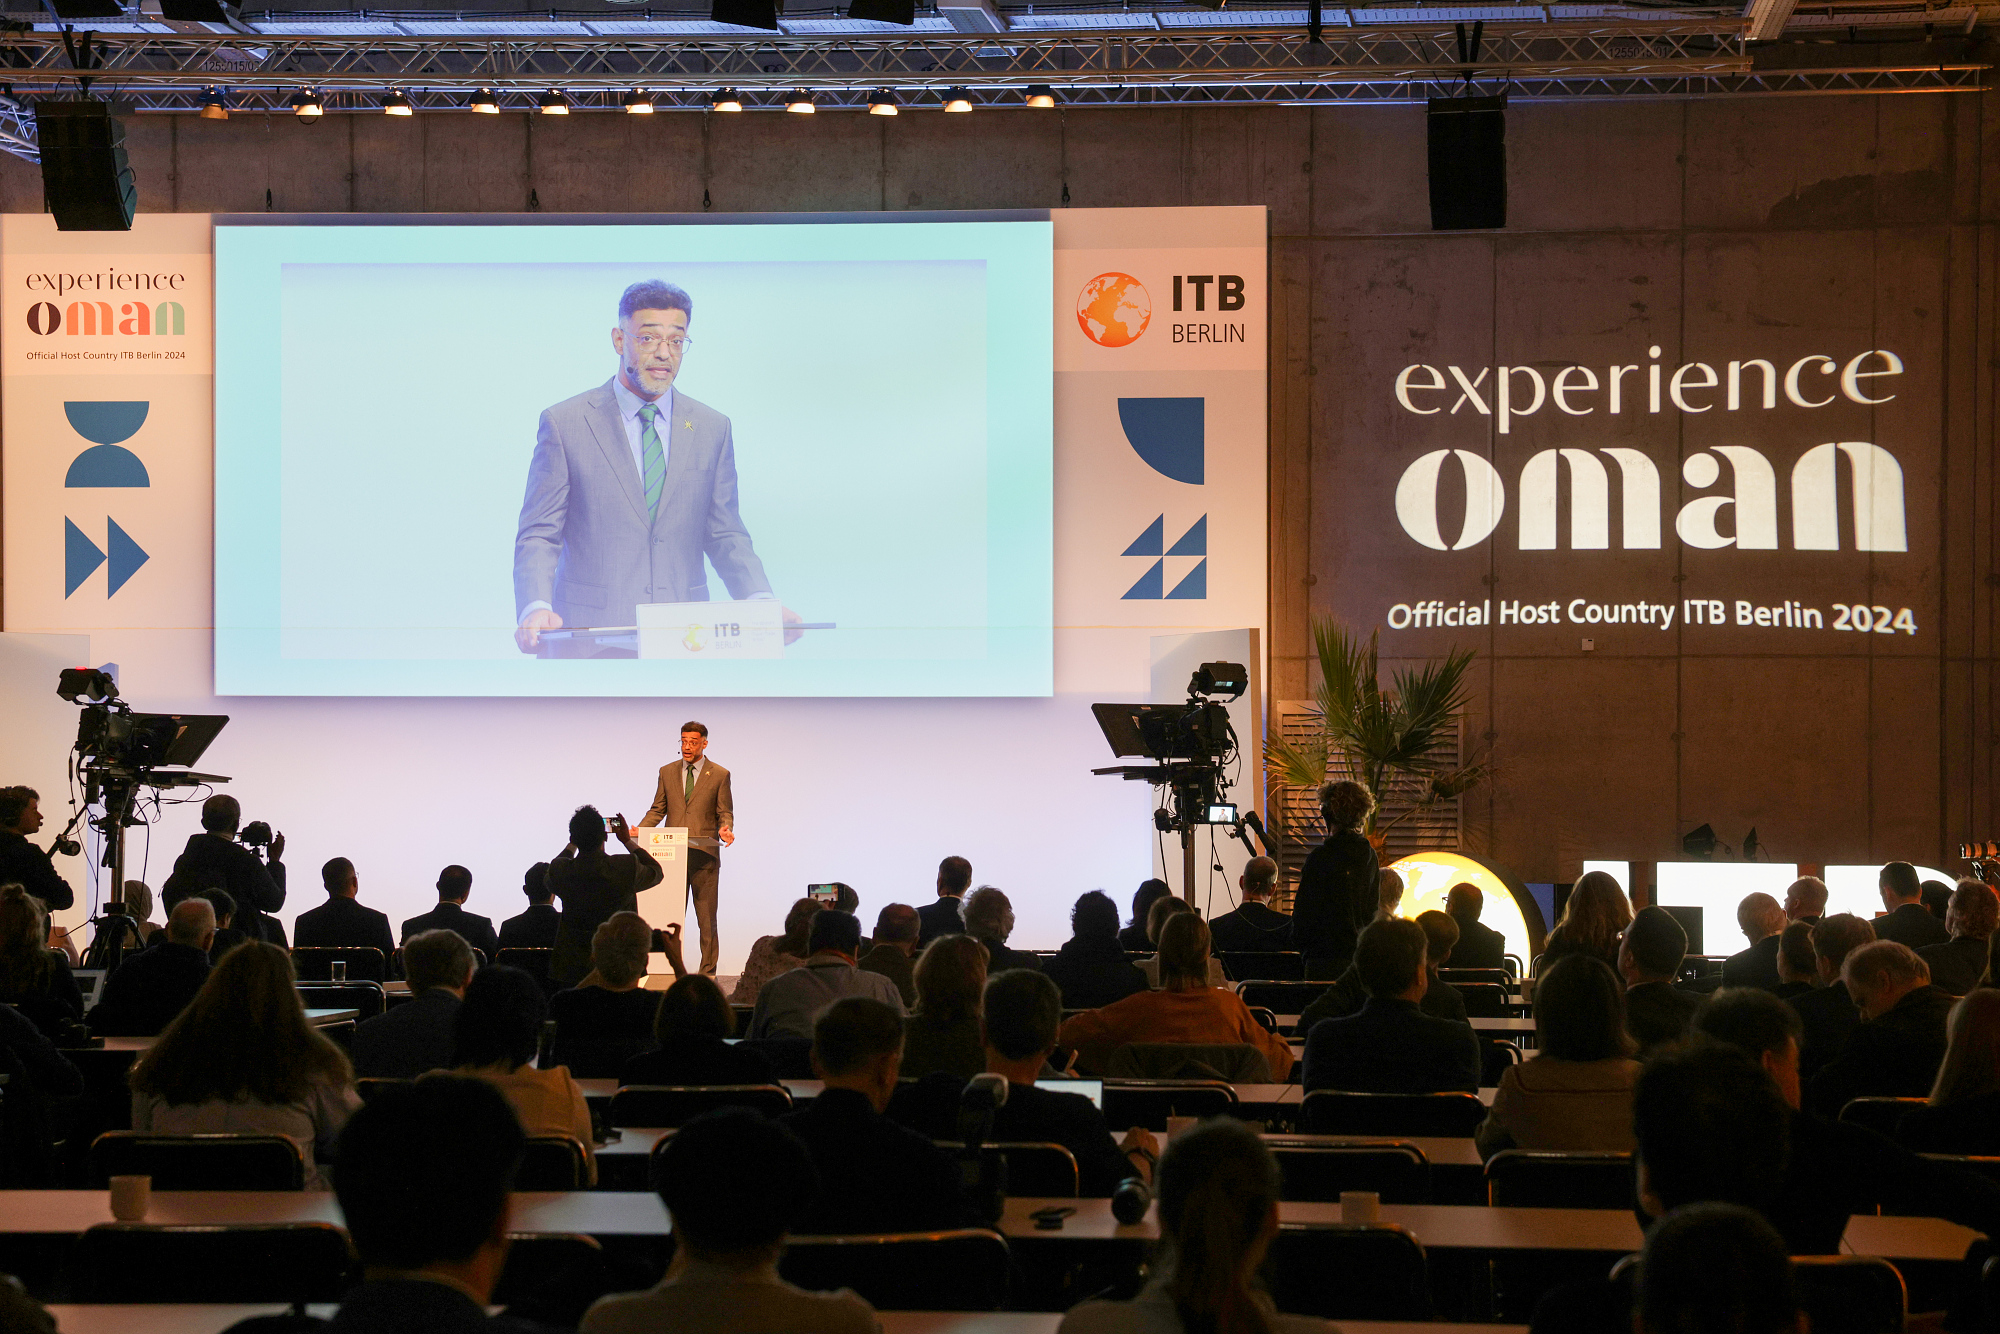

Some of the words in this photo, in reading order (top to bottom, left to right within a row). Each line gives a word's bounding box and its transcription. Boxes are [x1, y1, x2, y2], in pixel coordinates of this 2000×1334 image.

[26, 267, 185, 296] experience
[1172, 275, 1246, 312] ITB
[26, 301, 186, 336] oman
[1172, 323, 1245, 343] BERLIN
[26, 352, 58, 360] Official
[60, 352, 81, 360] Host
[82, 352, 118, 362] Country
[120, 352, 134, 360] ITB
[136, 351, 162, 360] Berlin
[164, 352, 186, 360] 2024
[1395, 345, 1904, 434] experience
[1395, 442, 1908, 552] oman
[714, 622, 741, 638] ITB
[1387, 599, 1490, 630] Official
[1499, 600, 1561, 625] Host
[1567, 599, 1675, 631] Country
[1683, 599, 1726, 625] ITB
[1735, 600, 1824, 629] Berlin
[1832, 603, 1918, 635] 2024
